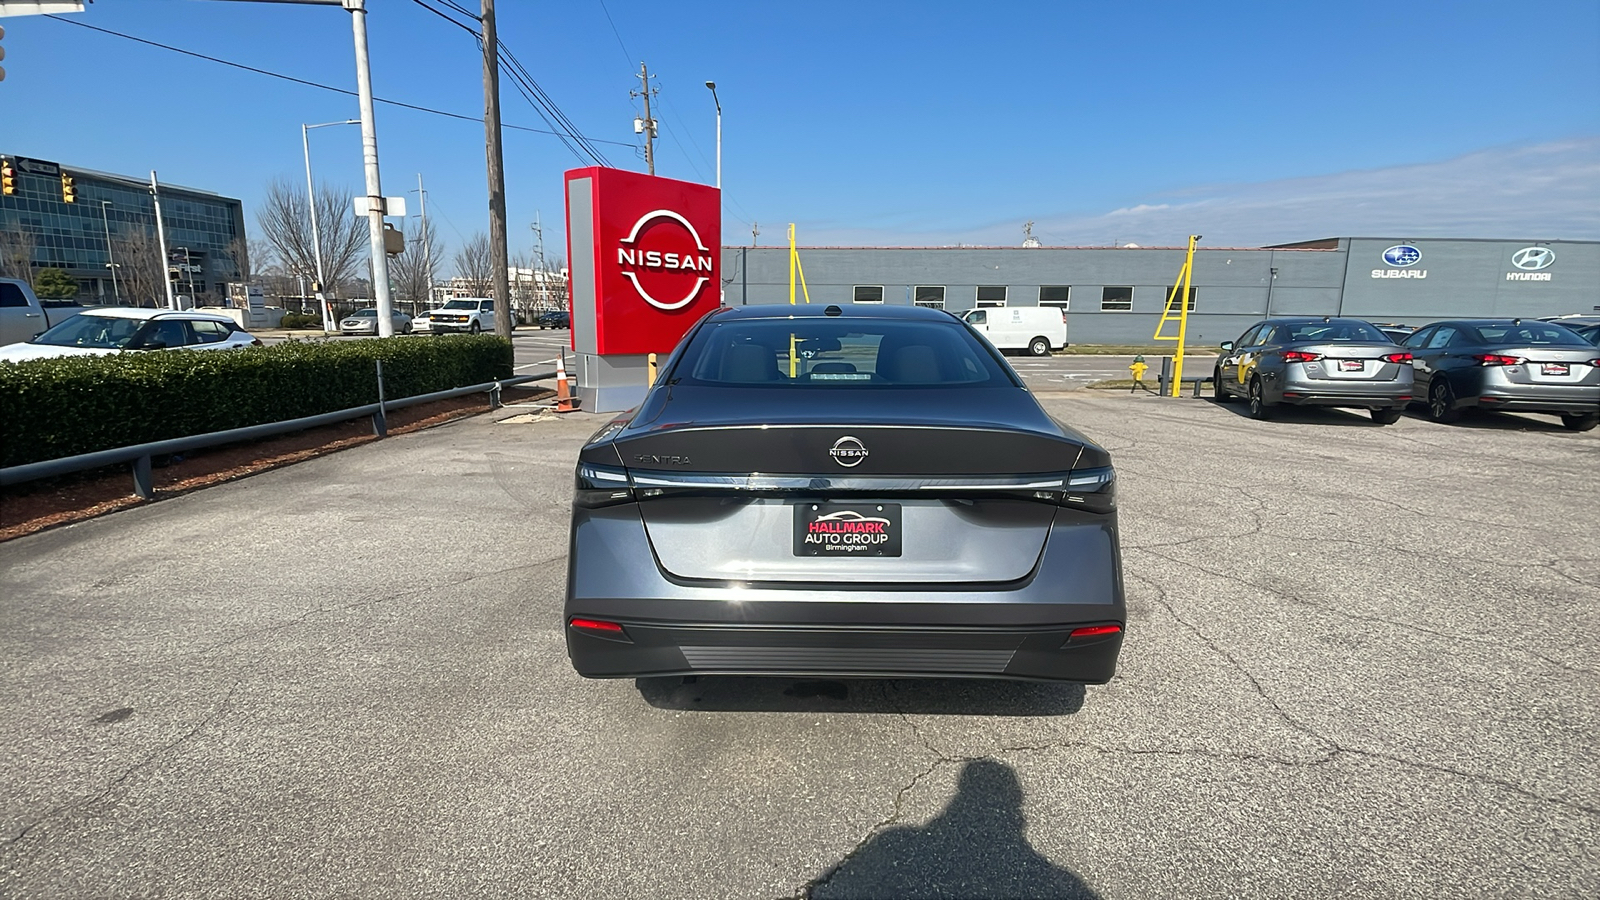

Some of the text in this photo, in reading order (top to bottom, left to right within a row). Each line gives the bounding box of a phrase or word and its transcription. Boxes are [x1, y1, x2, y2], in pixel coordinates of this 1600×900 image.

[617, 247, 712, 271] NISSAN
[1371, 269, 1428, 279] SUBARU
[1506, 272, 1552, 281] HYUNDAI
[633, 453, 693, 465] SENTRA
[808, 522, 885, 533] HALLMARK
[804, 533, 888, 544] AUTO GROUP
[825, 544, 868, 552] Birmingham
